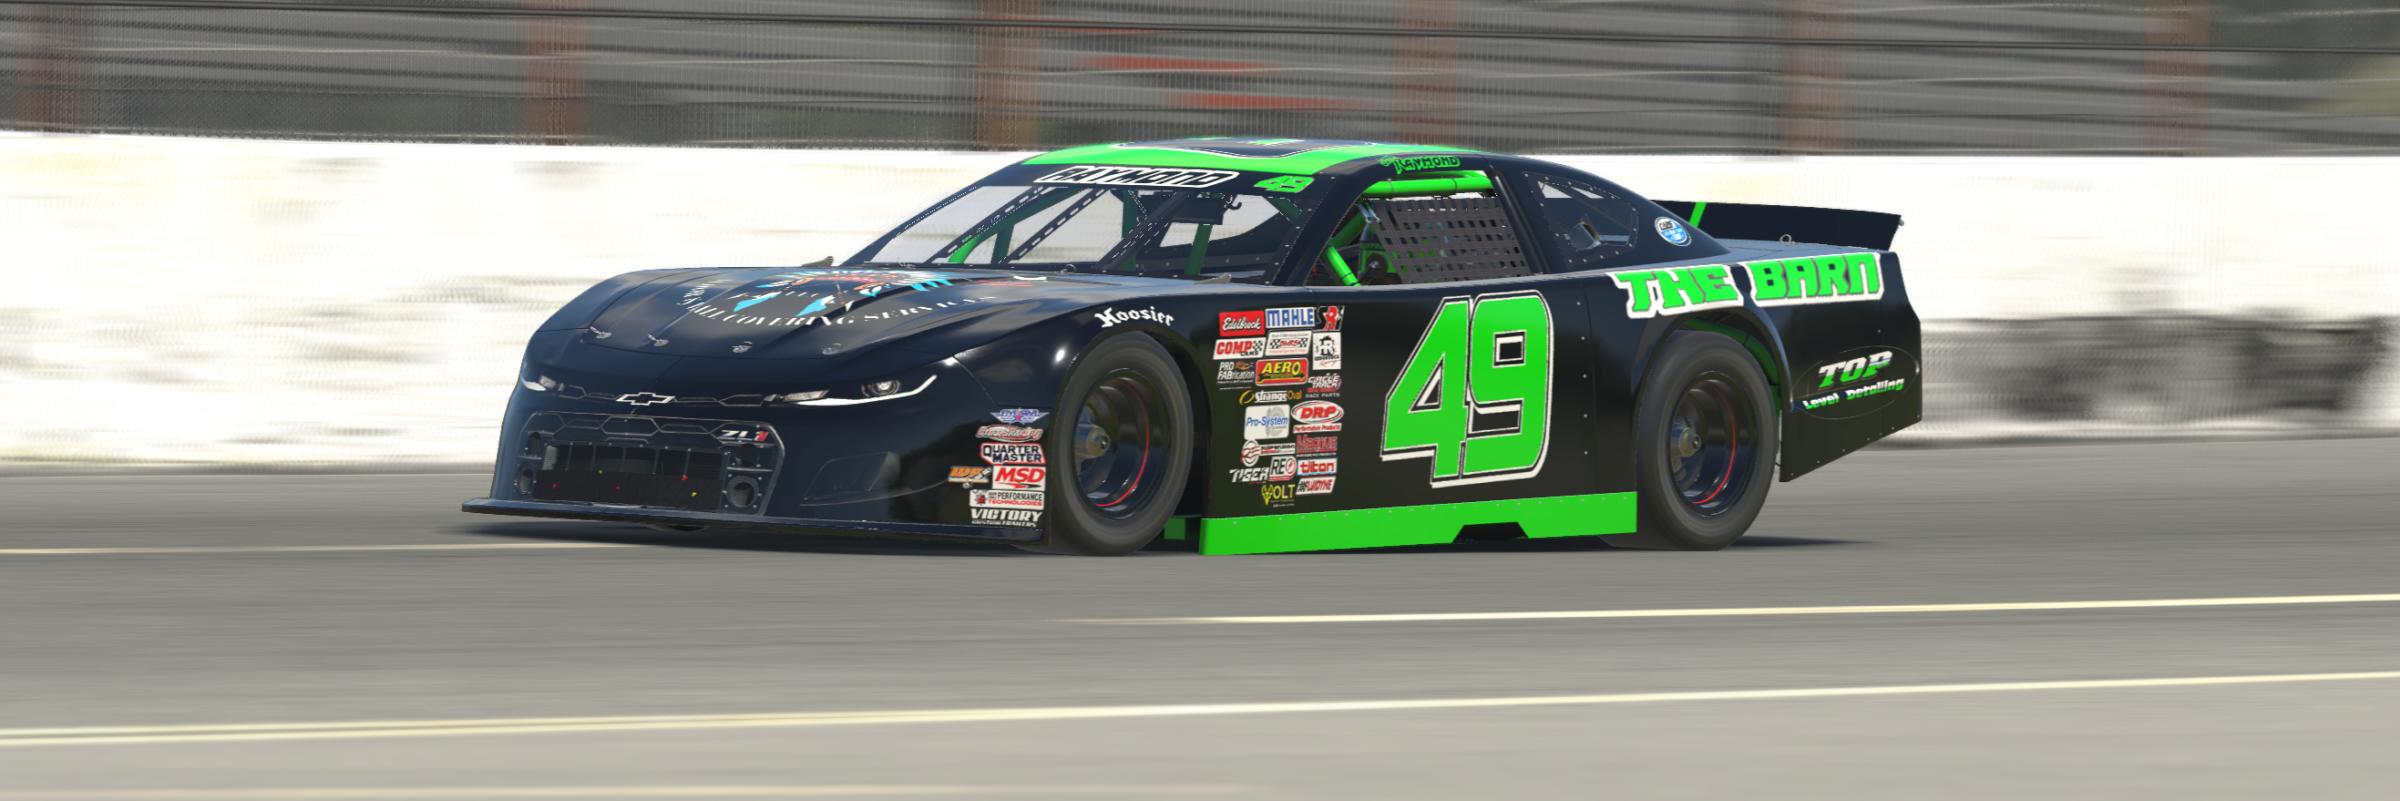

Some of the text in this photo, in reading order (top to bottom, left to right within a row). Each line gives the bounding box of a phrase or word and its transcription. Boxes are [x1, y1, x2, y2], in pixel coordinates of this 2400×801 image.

[1034, 166, 1240, 188] RAYMOND
[1254, 175, 1314, 193] 49
[1606, 251, 1885, 319] THE BARN
[1094, 305, 1175, 328] Hoosier
[1267, 309, 1314, 326] MAHLE
[1216, 341, 1253, 355] COMP
[1262, 361, 1301, 375] AERO
[1818, 350, 1893, 388] TOP
[1380, 290, 1554, 488] 49
[1802, 393, 1840, 410] Level
[1300, 406, 1337, 419] DRP
[983, 445, 1039, 457] QUARTER
[993, 453, 1042, 463] MASTER
[995, 467, 1045, 483] MSD
[970, 508, 1043, 522] VICTORY
